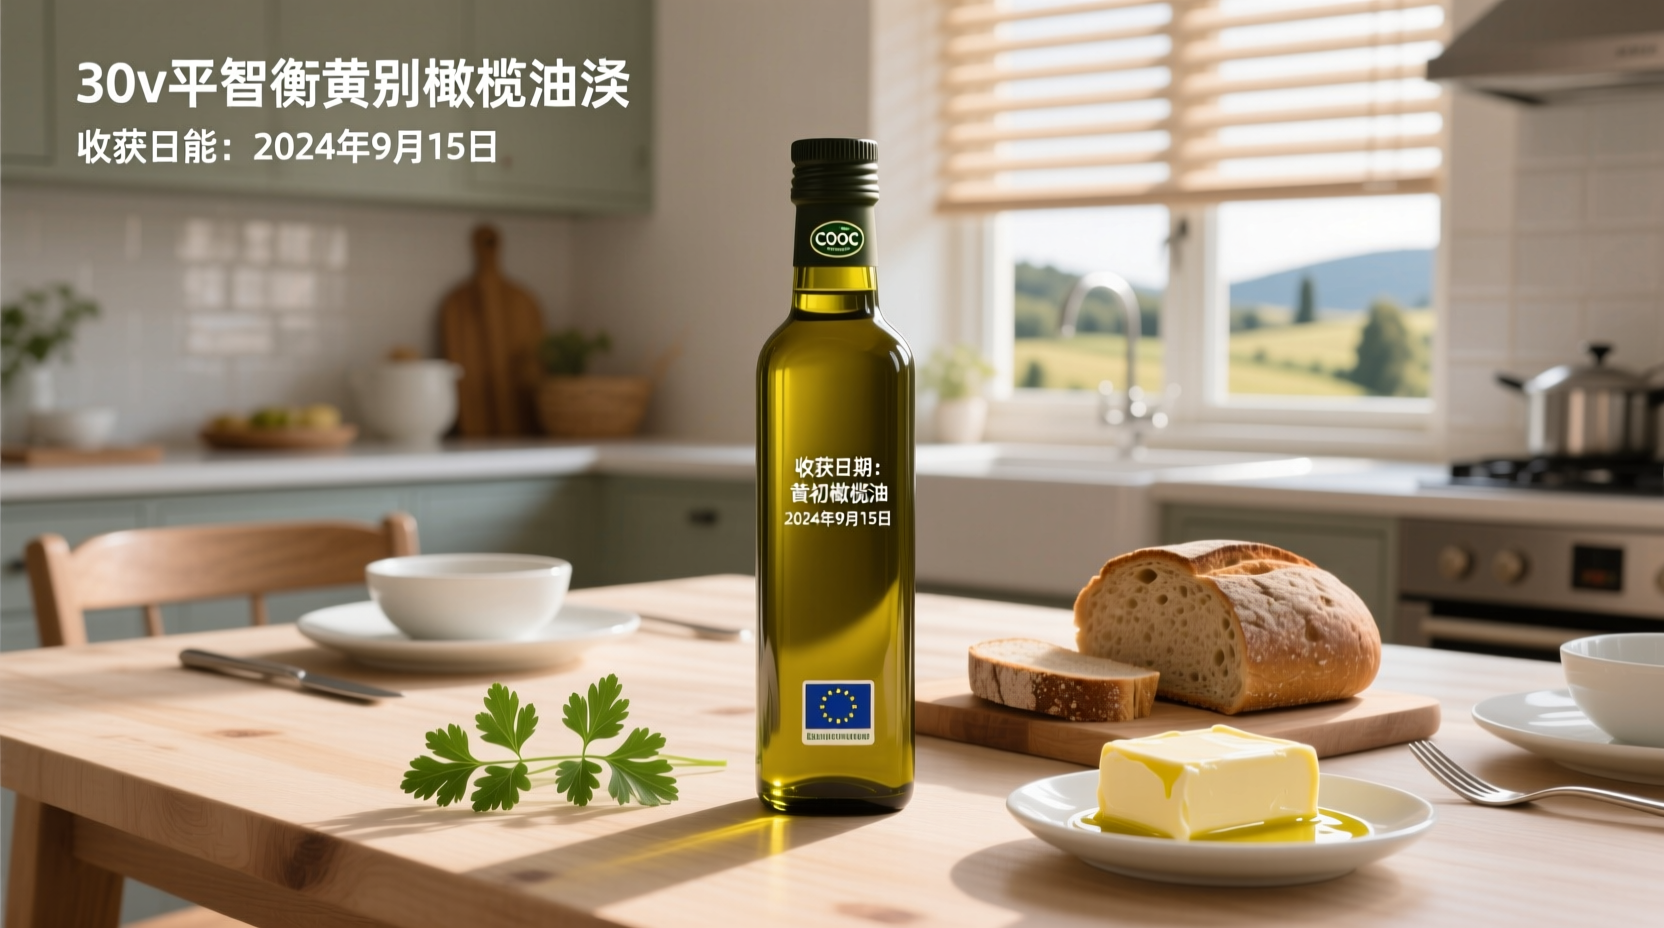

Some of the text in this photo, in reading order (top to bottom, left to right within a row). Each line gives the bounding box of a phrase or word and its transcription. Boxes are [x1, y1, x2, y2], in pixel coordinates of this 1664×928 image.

[815, 231, 859, 247] COOC
[795, 456, 881, 479] 收获日期：
[784, 510, 891, 527] 2024年9月15日
